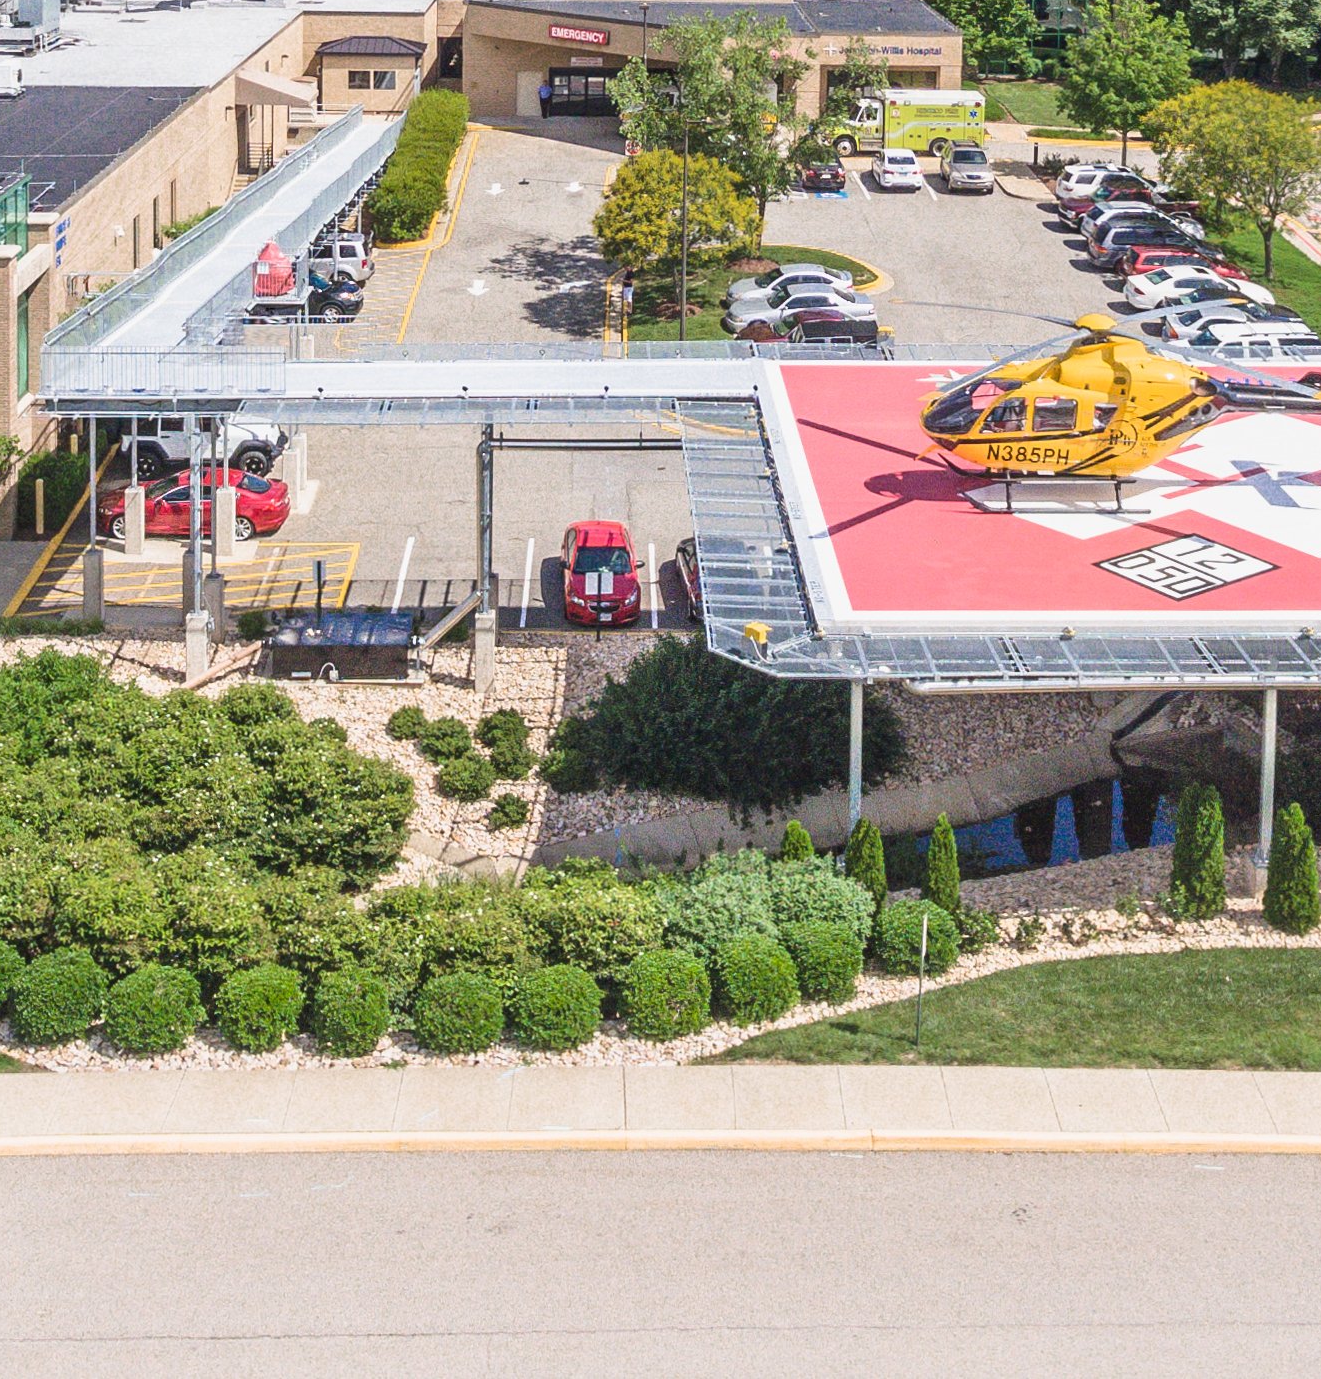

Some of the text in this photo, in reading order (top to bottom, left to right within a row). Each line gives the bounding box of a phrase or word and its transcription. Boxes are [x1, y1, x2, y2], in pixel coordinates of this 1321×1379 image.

[551, 26, 605, 43] EMERGENCY
[906, 47, 942, 57] Hospital
[986, 444, 1070, 465] N385PH
